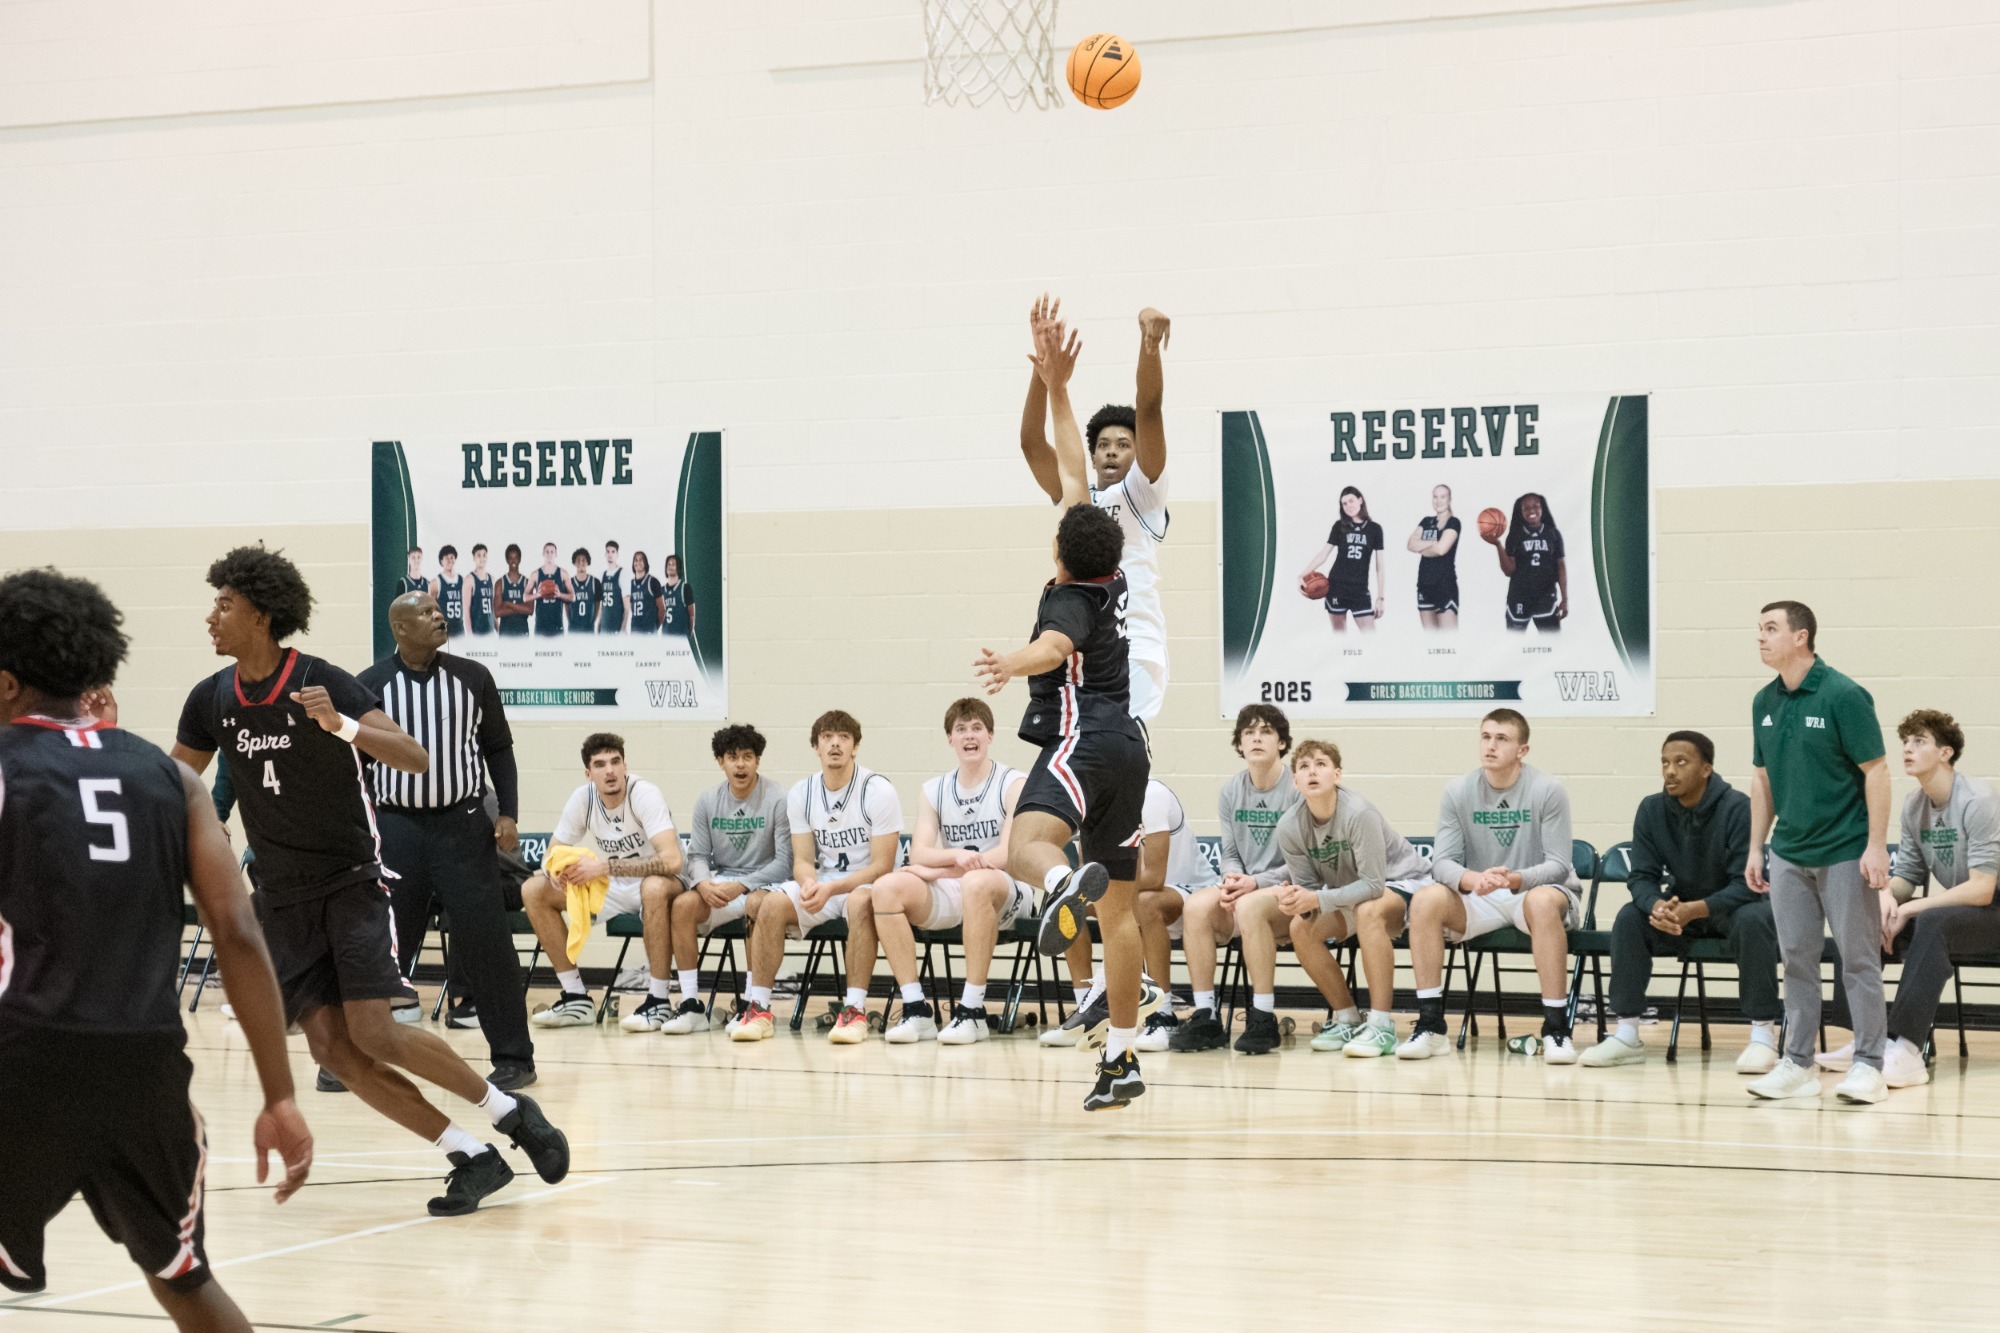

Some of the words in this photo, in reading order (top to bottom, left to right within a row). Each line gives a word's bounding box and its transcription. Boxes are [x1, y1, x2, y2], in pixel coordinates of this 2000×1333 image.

[1330, 404, 1539, 462] RESERVE
[462, 439, 632, 488] RESERVE
[1346, 533, 1367, 545] WRA
[1523, 539, 1548, 552] WRA
[1347, 545, 1363, 559] 25
[1531, 553, 1541, 566] 2
[482, 598, 492, 614] 51
[602, 592, 614, 607] 35
[446, 601, 460, 619] 55
[633, 601, 644, 616] 12
[645, 680, 698, 708] WRA
[1260, 681, 1312, 703] 2025
[1370, 685, 1396, 699] GIRLS
[1399, 685, 1453, 699] BASKETBALL
[1456, 684, 1495, 698] SENIORS
[1554, 671, 1620, 702] WRA
[498, 690, 513, 705] OYS
[516, 690, 560, 705] BASKETBALL
[563, 690, 595, 705] SENIORS
[1805, 716, 1825, 729] WRA
[236, 728, 292, 759] Spire
[262, 760, 280, 795] 4
[78, 778, 131, 862] 5
[712, 816, 765, 830] RESERVE
